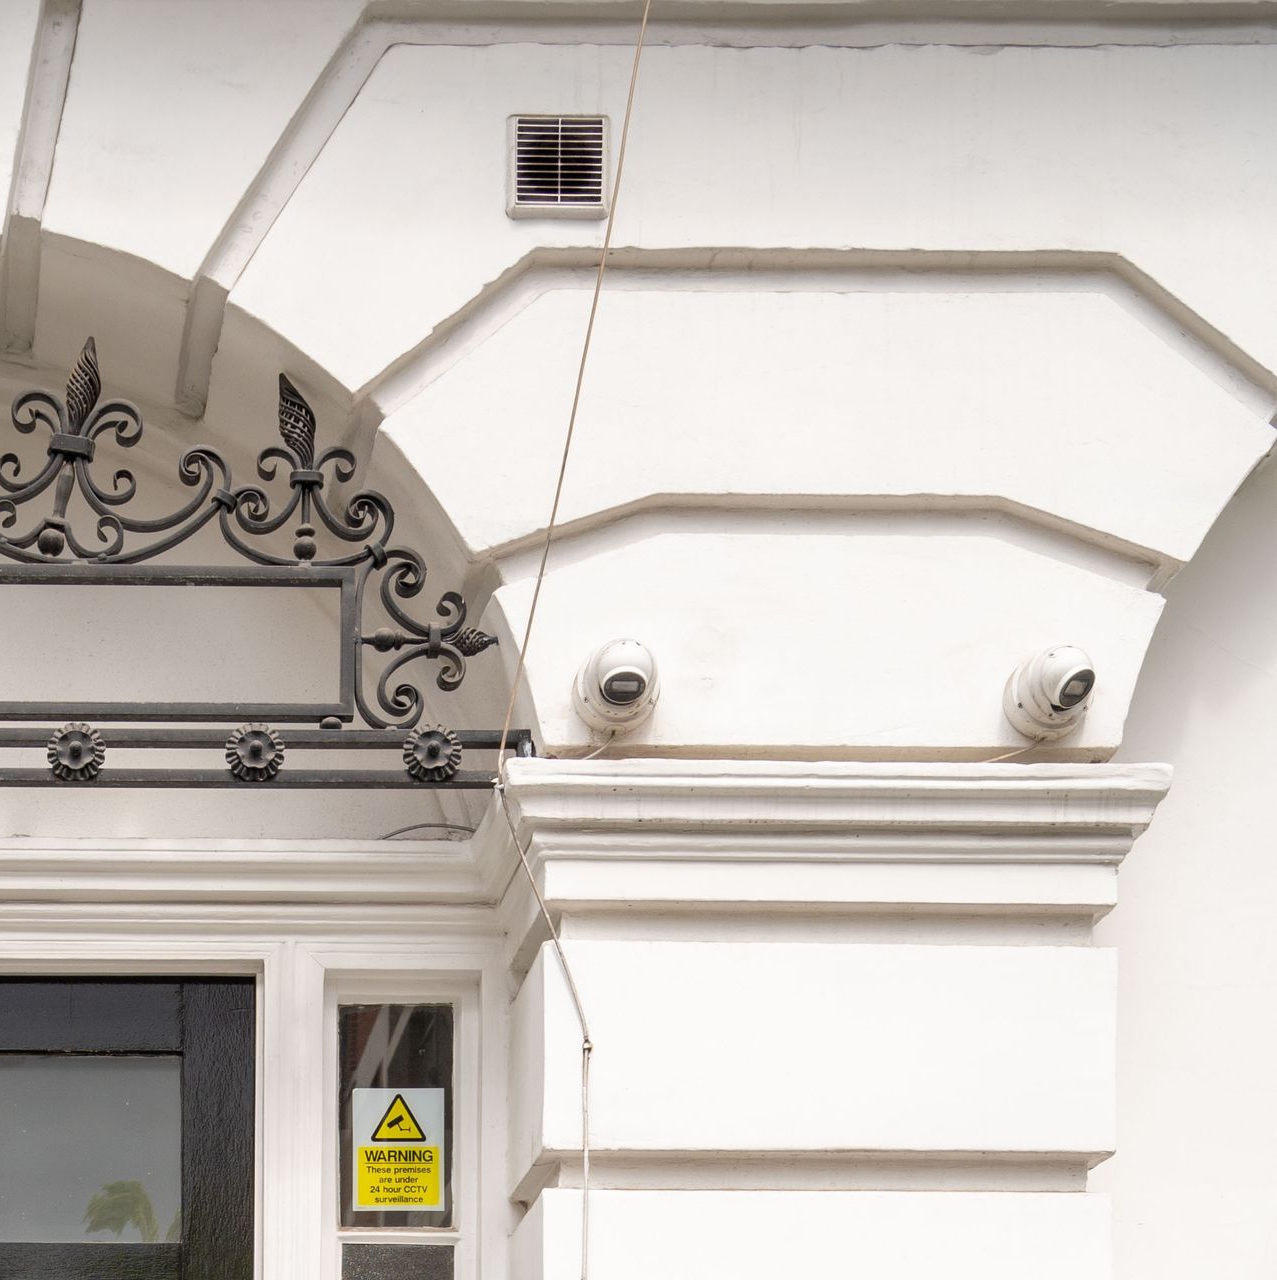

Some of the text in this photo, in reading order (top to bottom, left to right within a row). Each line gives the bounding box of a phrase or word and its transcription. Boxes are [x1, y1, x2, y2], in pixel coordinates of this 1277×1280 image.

[365, 1150, 433, 1162] WARNING
[367, 1166, 431, 1175] These premises
[395, 1176, 418, 1184] under
